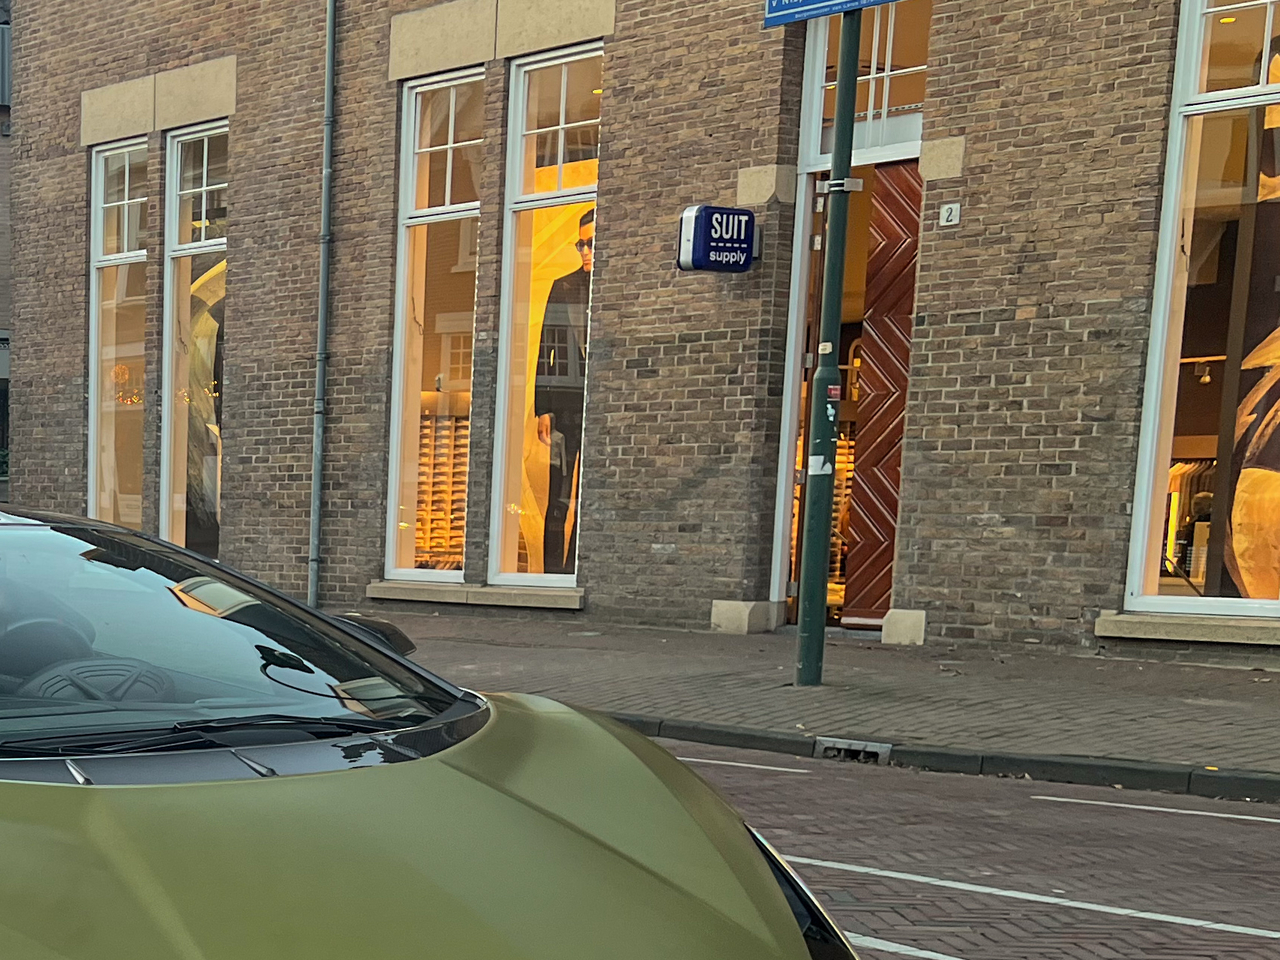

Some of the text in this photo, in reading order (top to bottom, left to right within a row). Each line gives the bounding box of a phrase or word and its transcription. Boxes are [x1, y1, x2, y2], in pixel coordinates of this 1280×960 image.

[945, 207, 953, 223] 2
[711, 213, 749, 240] SUIT
[709, 250, 747, 264] supply
